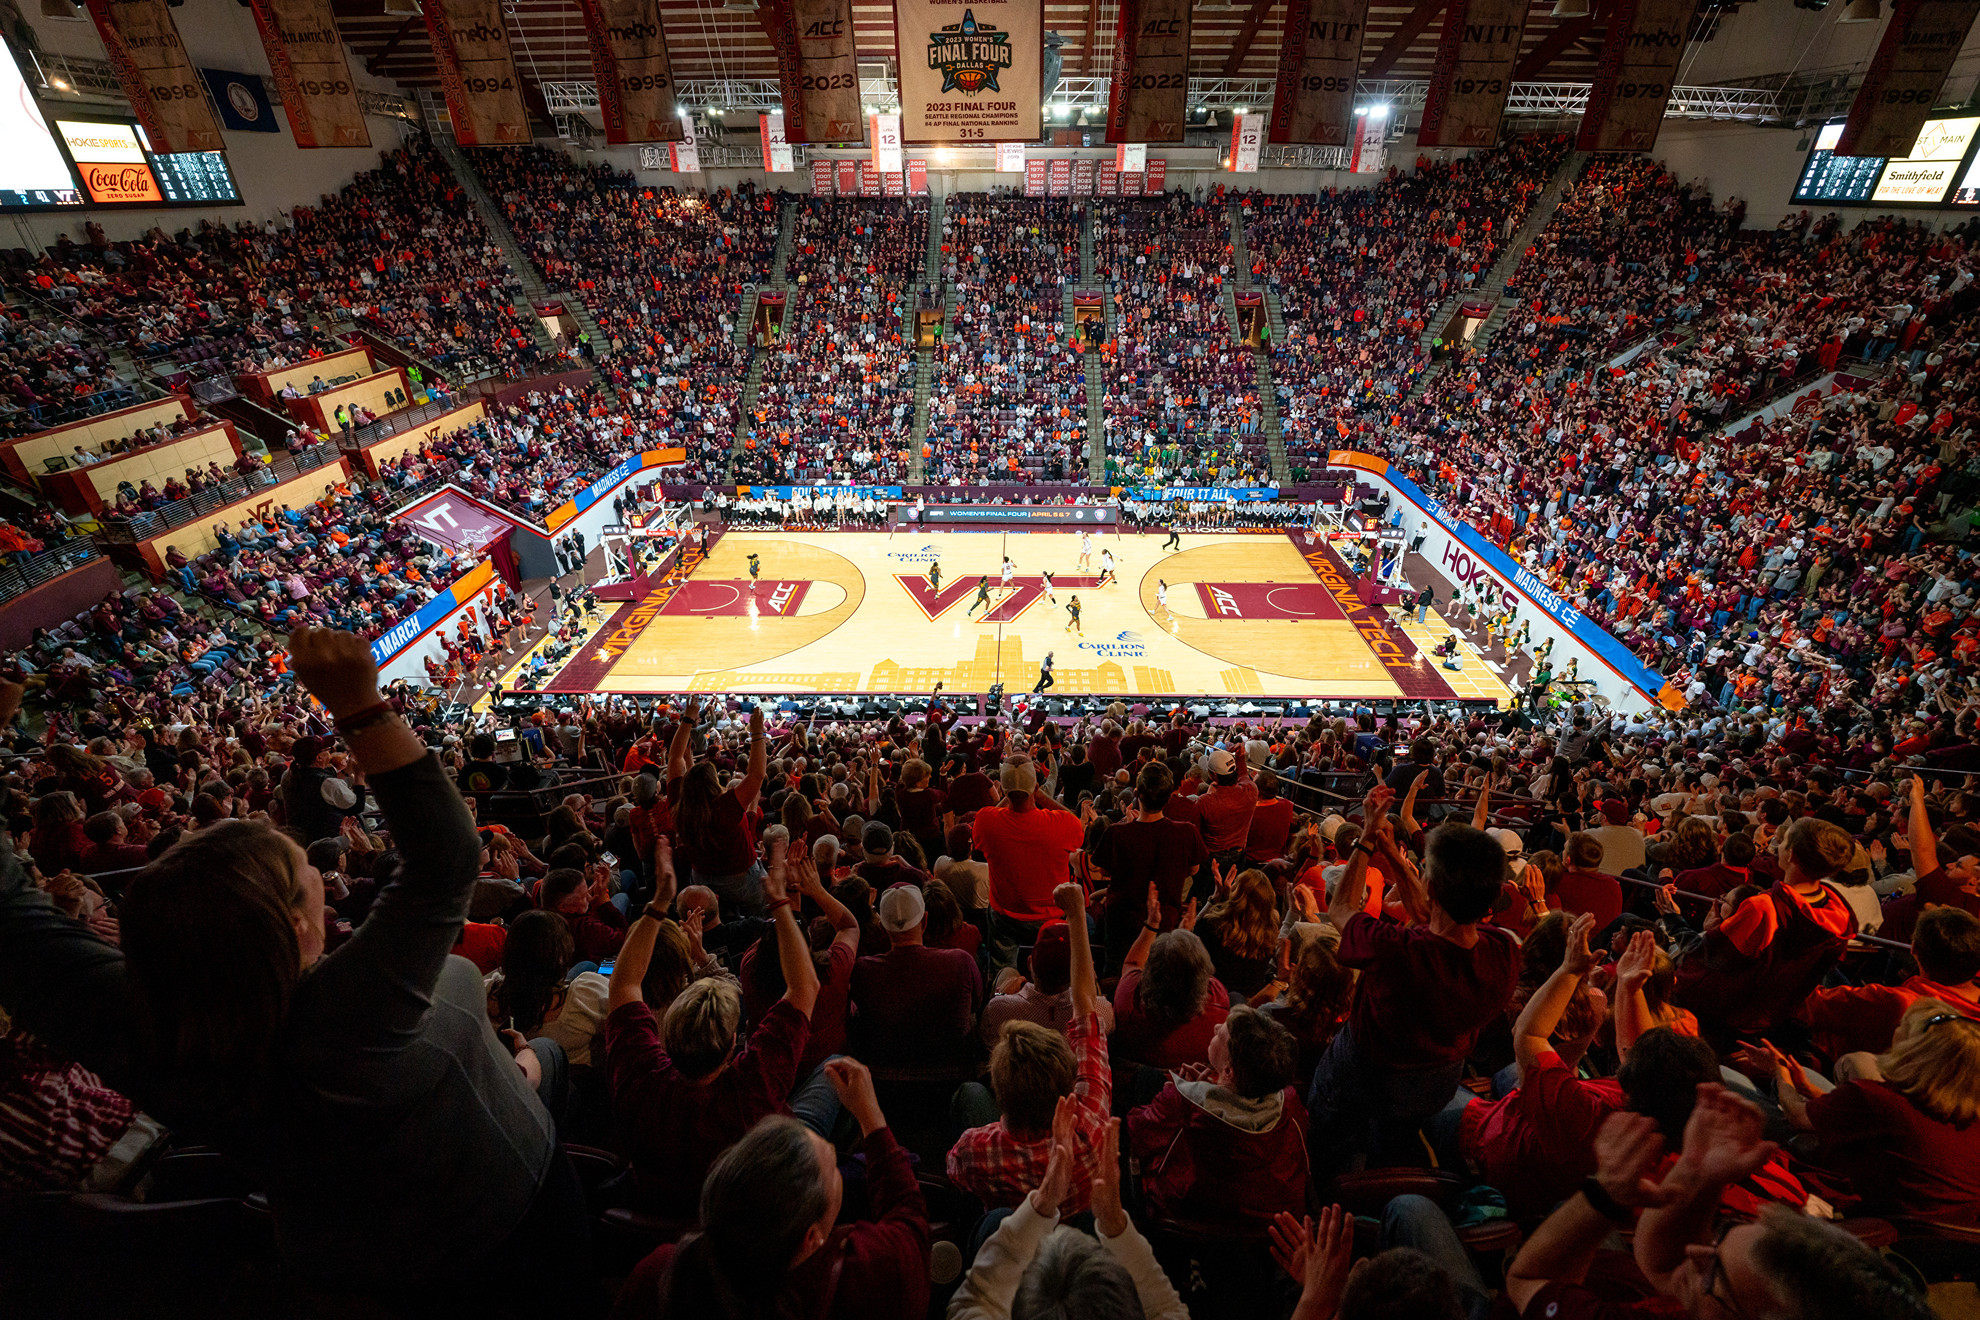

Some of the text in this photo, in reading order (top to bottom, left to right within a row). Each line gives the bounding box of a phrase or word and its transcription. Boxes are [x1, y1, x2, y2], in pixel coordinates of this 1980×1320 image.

[452, 22, 502, 42] metro
[606, 20, 657, 41] metro
[804, 20, 844, 36] ACC
[1142, 19, 1182, 34] ACC
[1308, 21, 1360, 42] NIT
[1463, 25, 1519, 43] NIT
[282, 29, 336, 44] ATLANTIC 10
[1627, 27, 1681, 48] metro
[930, 44, 1010, 65] FINAL FOUR
[299, 80, 350, 95] 1999
[463, 77, 514, 93] 1994
[620, 74, 667, 92] 1995
[801, 74, 855, 91] 2023
[1131, 74, 1184, 90] 2022
[1300, 76, 1350, 92] 1995
[1453, 79, 1503, 95] 1973
[149, 84, 198, 101] 1998
[1615, 83, 1664, 99] 1979
[1879, 89, 1933, 104] 1996
[926, 102, 1016, 112] 2023 FINAL FOUR
[882, 135, 896, 144] 12
[1242, 135, 1256, 144] 12
[1363, 136, 1381, 146] 44
[1940, 135, 1965, 144] MAIN
[90, 168, 150, 192] Coca-Cola
[1888, 170, 1945, 184] Smithfield
[35, 191, 50, 202] 41
[53, 191, 74, 202] VT
[424, 426, 441, 441] VT
[592, 470, 620, 498] MADNESS
[1166, 488, 1230, 500] FOUR IT ALL
[245, 498, 274, 521] VT
[414, 502, 458, 532] VT
[1304, 551, 1368, 614] VIRGINIA
[1513, 567, 1562, 613] MADNESS
[766, 581, 797, 614] ACC
[892, 573, 1114, 624] VT
[1211, 586, 1242, 617] ACC
[590, 585, 679, 661] VIRGINIA
[379, 615, 422, 658] MARCH
[1353, 616, 1412, 668] TECH
[1078, 642, 1145, 652] CARILION
[99, 772, 114, 786] 5
